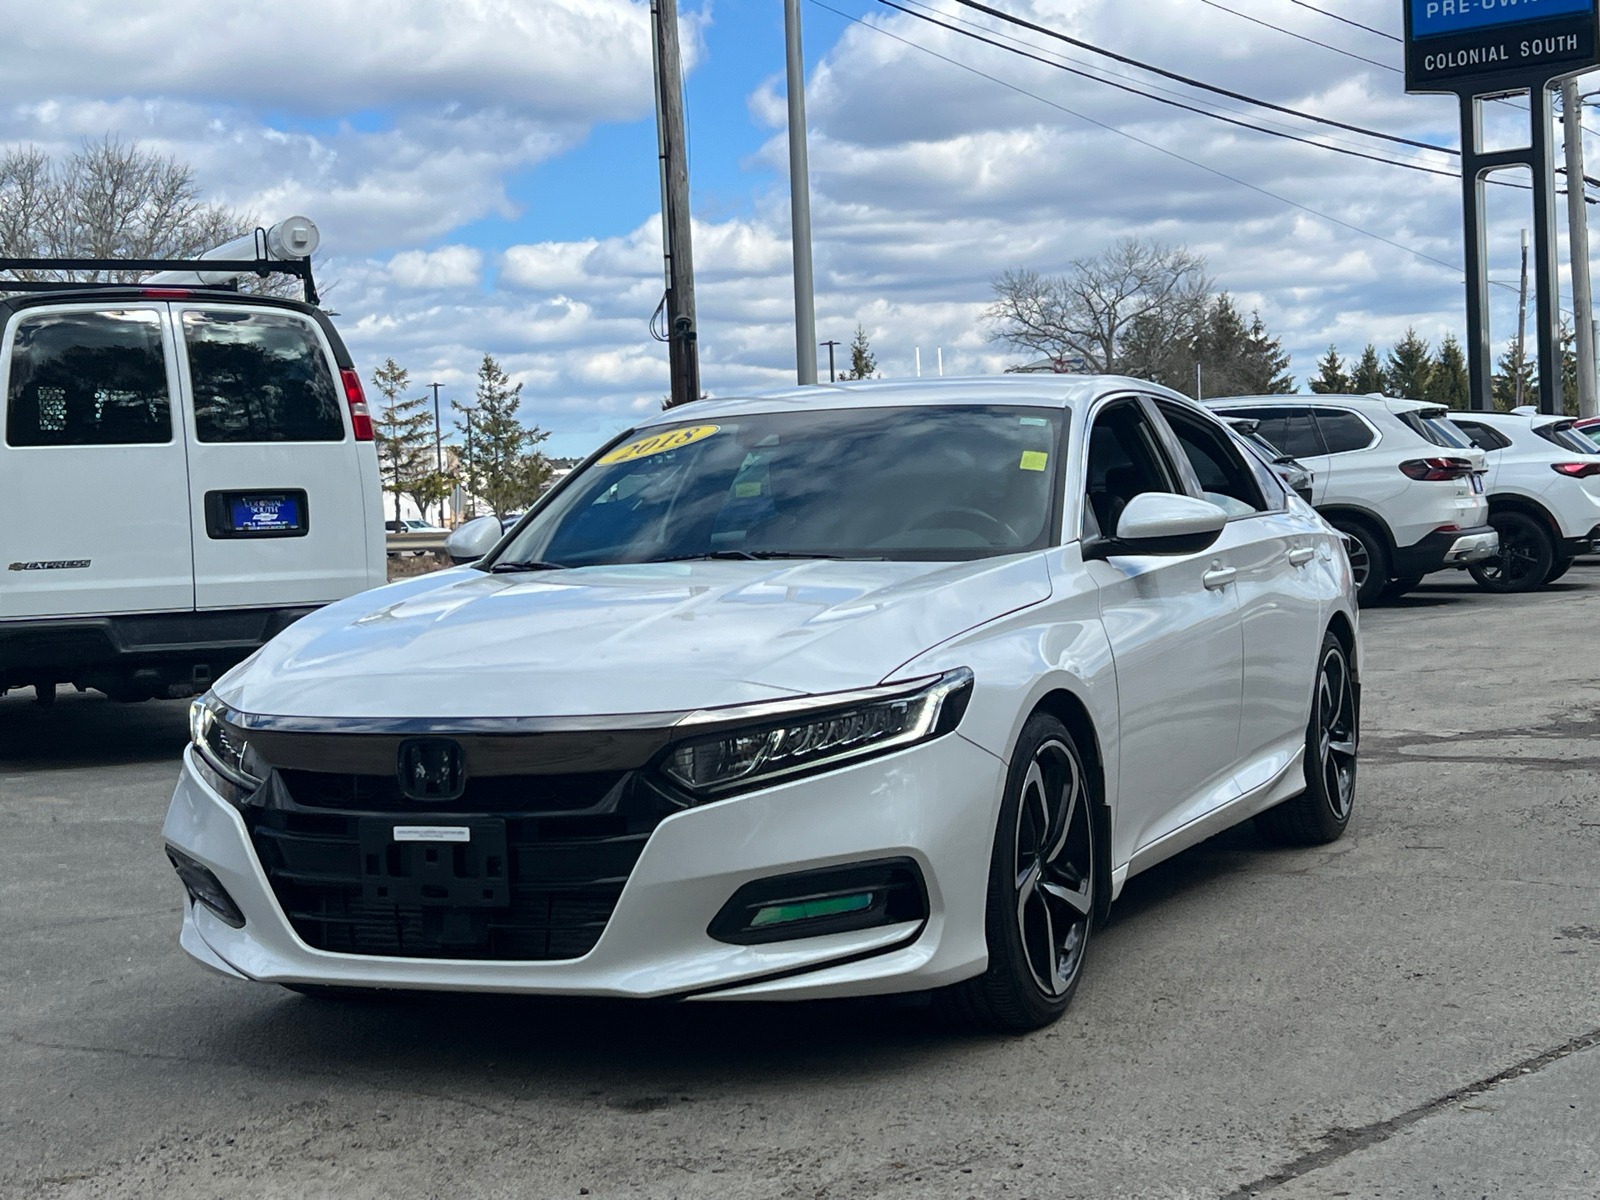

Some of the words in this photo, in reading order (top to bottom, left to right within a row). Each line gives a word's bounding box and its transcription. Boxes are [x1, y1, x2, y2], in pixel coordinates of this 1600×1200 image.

[1424, 45, 1509, 71] COLONIAL
[1520, 34, 1578, 57] SOUTH
[614, 428, 700, 460] 2018
[26, 560, 90, 569] EXPRESS
